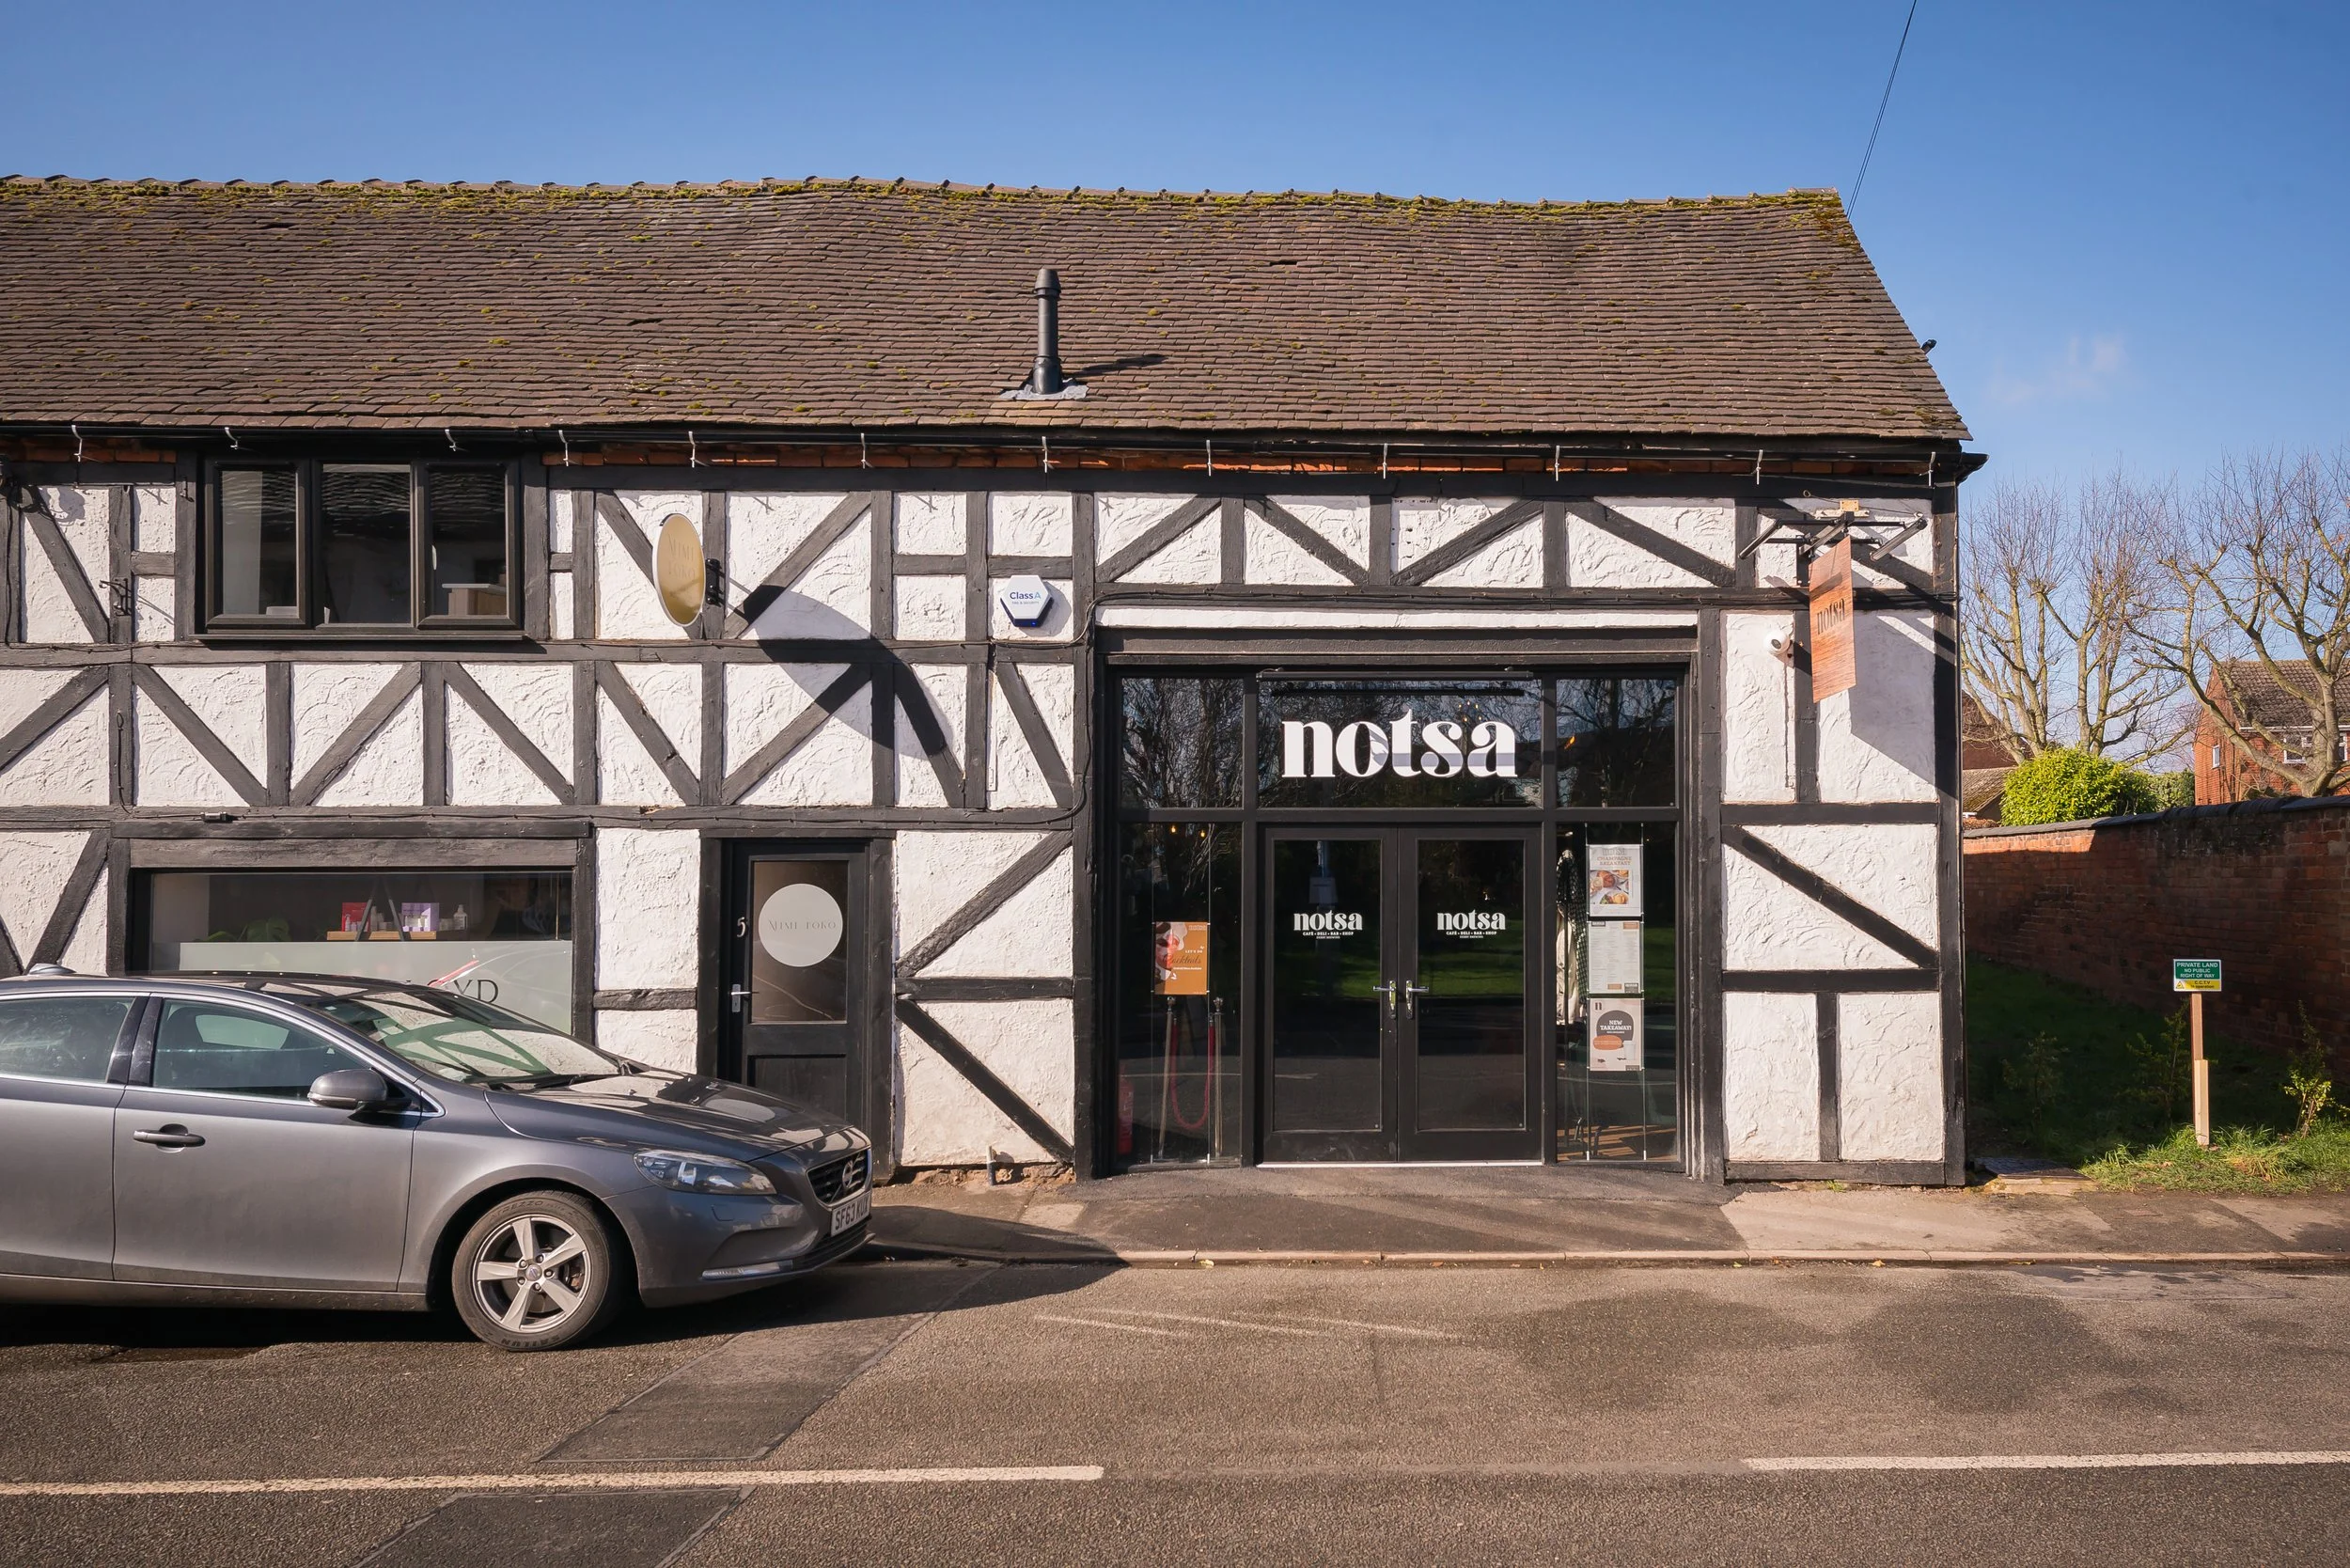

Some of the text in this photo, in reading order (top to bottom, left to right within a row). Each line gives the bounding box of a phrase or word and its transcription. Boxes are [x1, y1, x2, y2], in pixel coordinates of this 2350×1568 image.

[1816, 598, 1845, 635] notsa
[1281, 708, 1518, 777] notsa
[736, 917, 746, 937] 5
[1293, 910, 1363, 931] notsa
[1436, 909, 1506, 931] notsa
